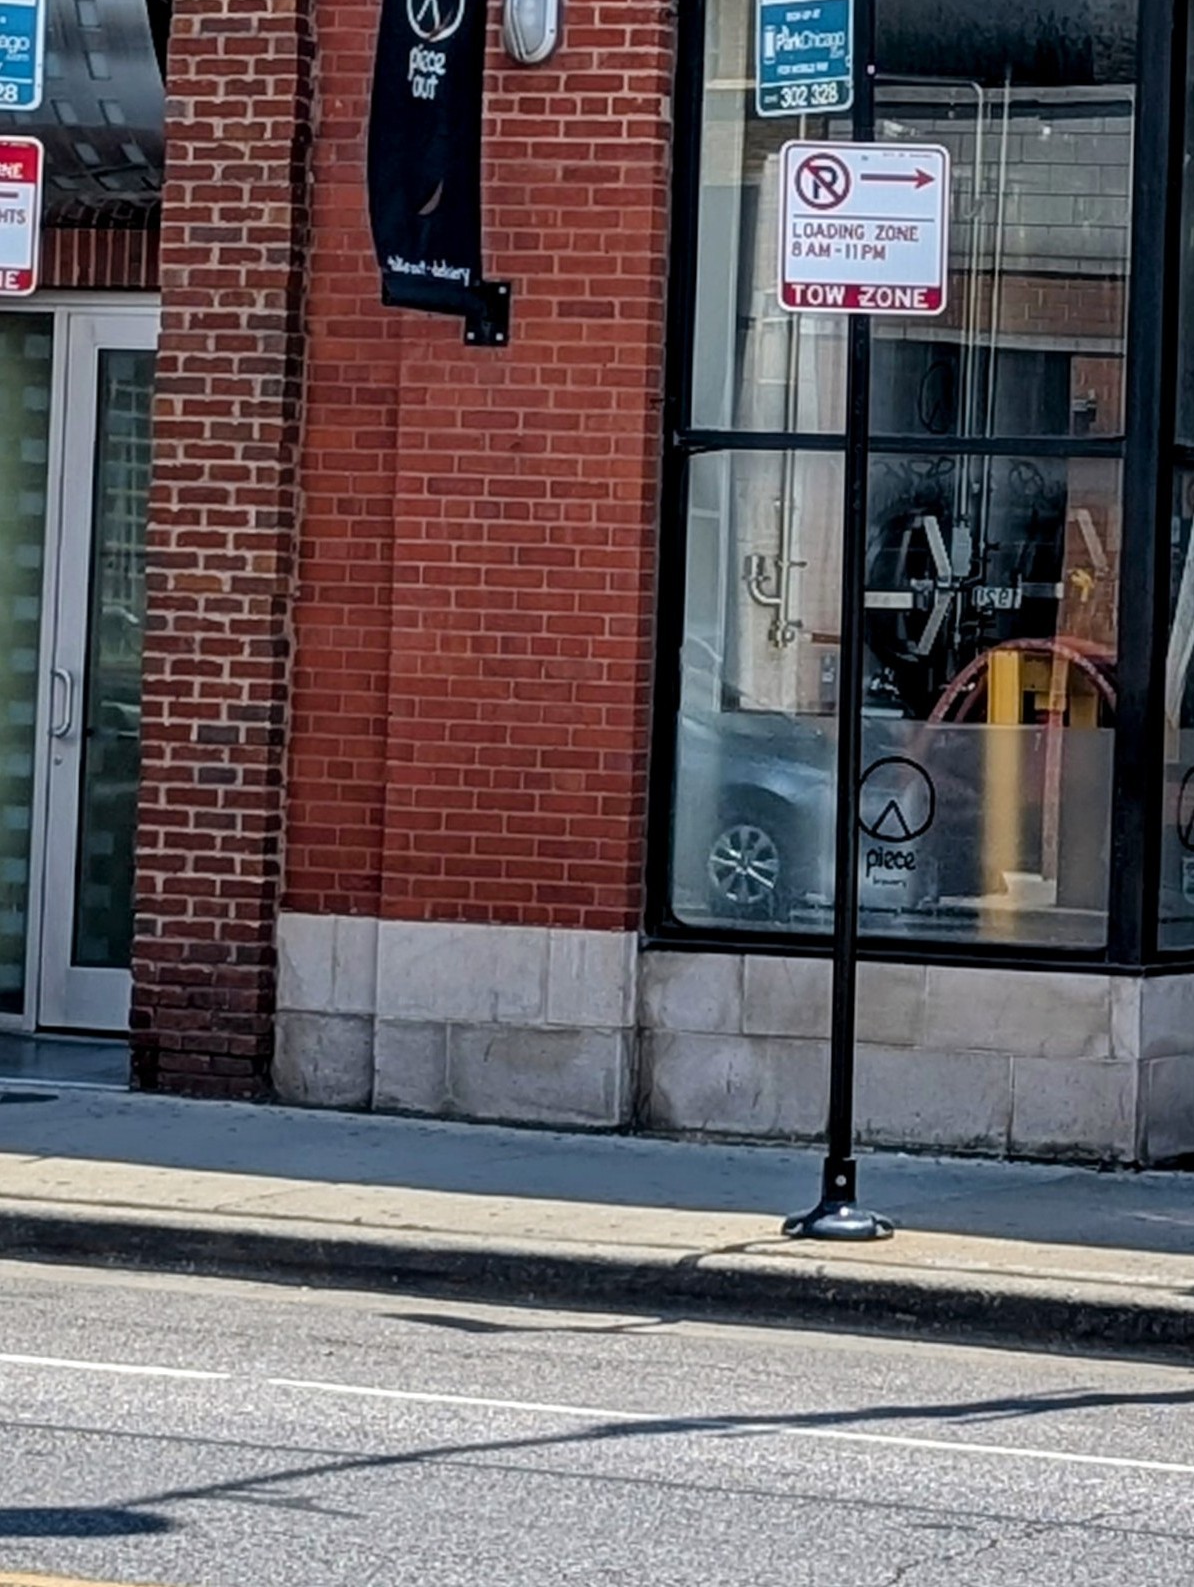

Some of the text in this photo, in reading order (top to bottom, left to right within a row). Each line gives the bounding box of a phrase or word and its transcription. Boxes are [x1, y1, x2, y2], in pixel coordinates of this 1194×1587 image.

[408, 43, 447, 81] piece
[412, 75, 439, 100] out
[792, 223, 919, 243] LOADING ZONE
[791, 284, 929, 309] TOW ZONE
[866, 847, 917, 878] piece
